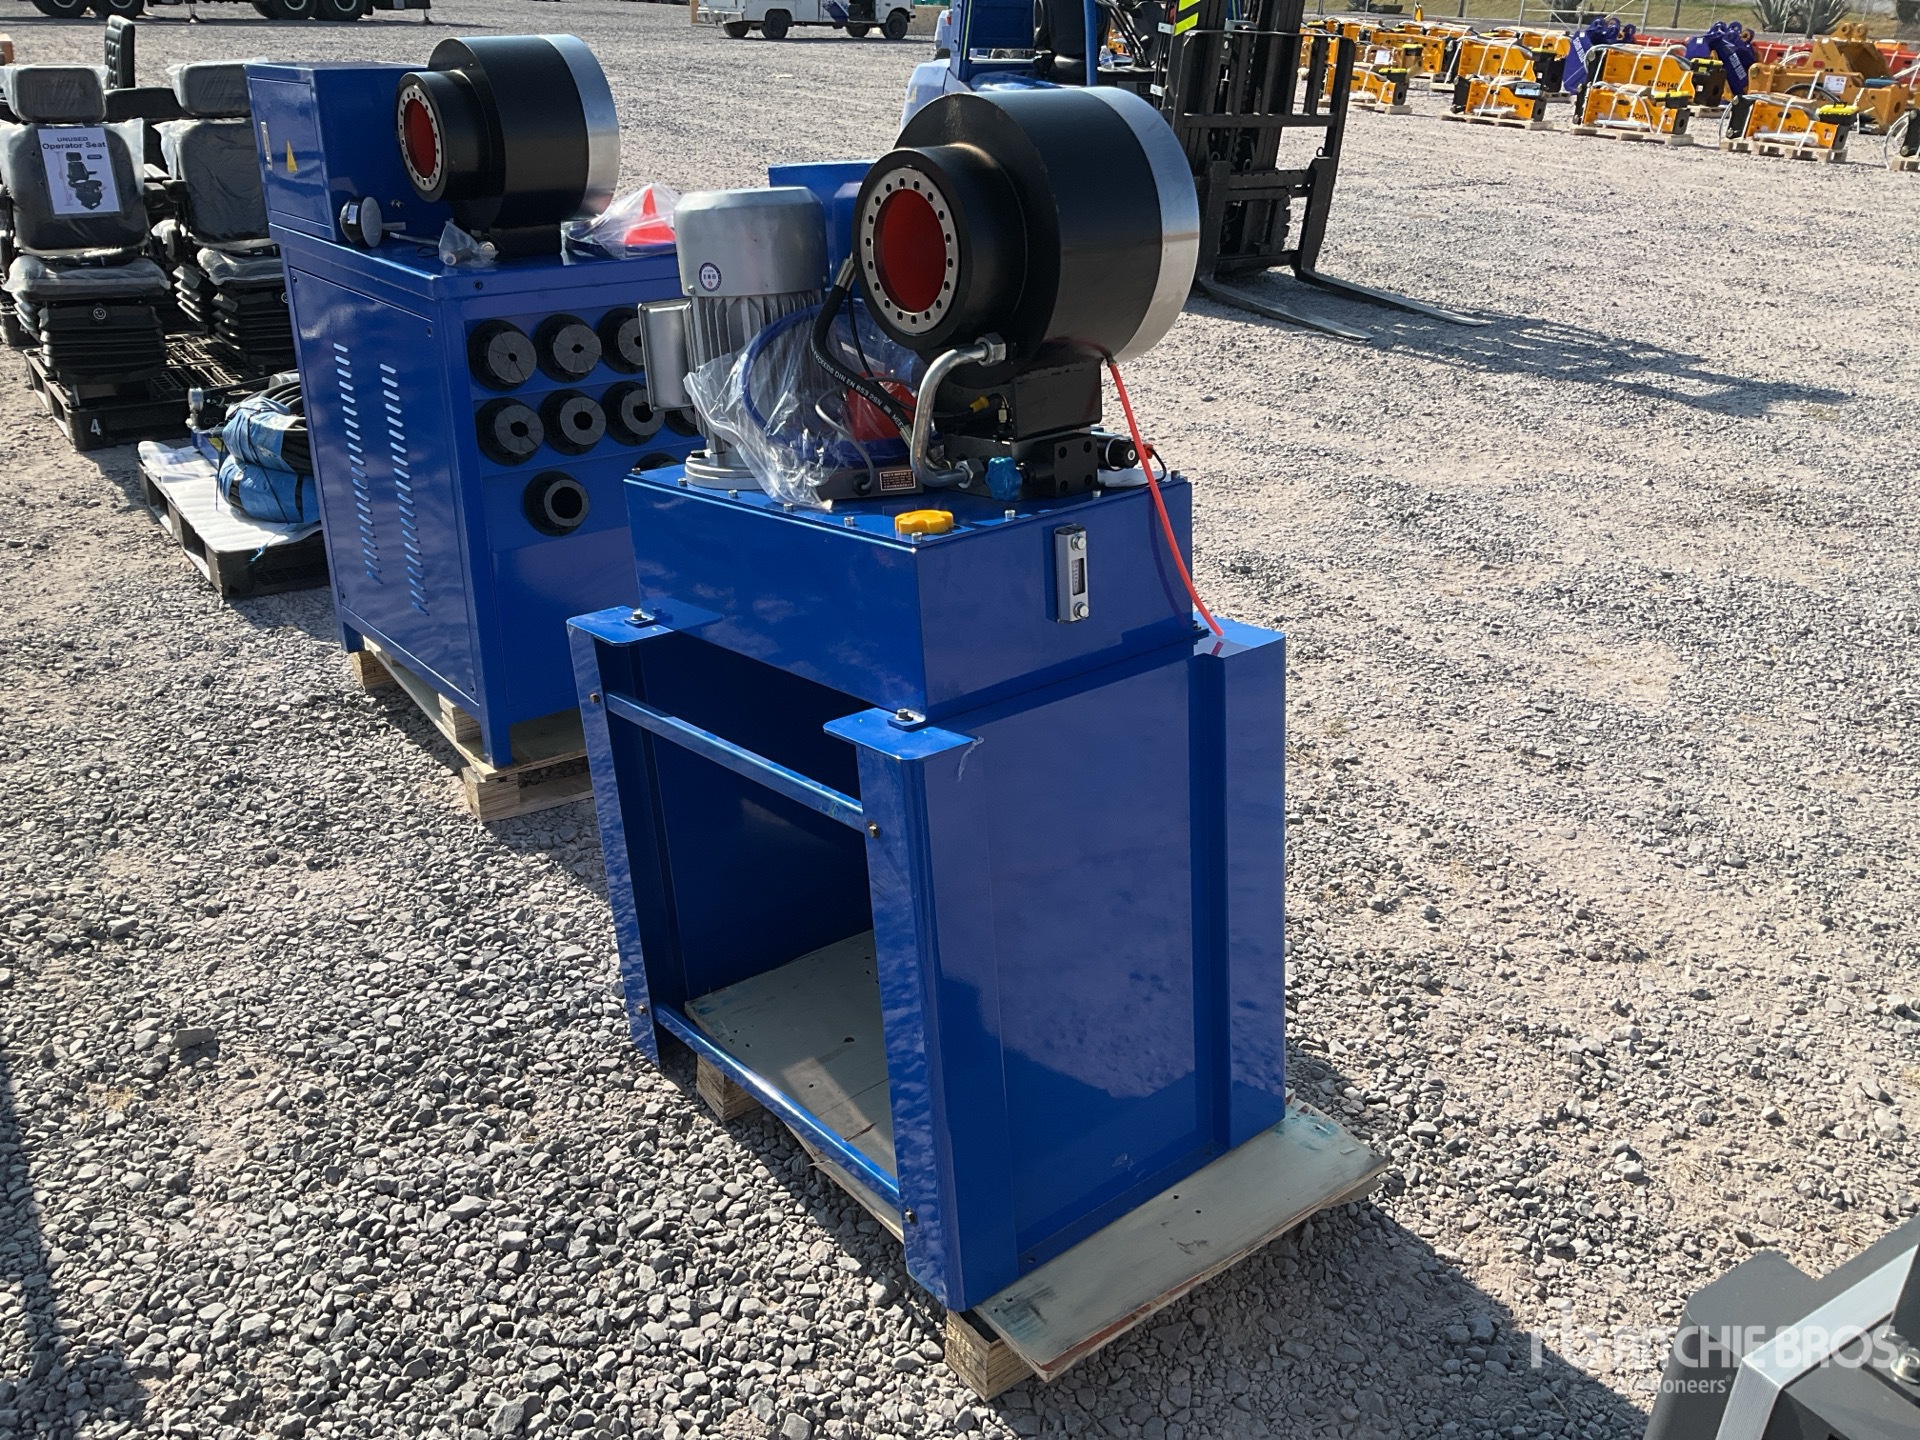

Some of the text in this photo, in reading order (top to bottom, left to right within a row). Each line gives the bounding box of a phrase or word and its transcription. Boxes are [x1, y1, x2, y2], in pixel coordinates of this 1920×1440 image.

[834, 370, 846, 382] DIN
[846, 379, 856, 389] EN
[90, 418, 101, 436] 4
